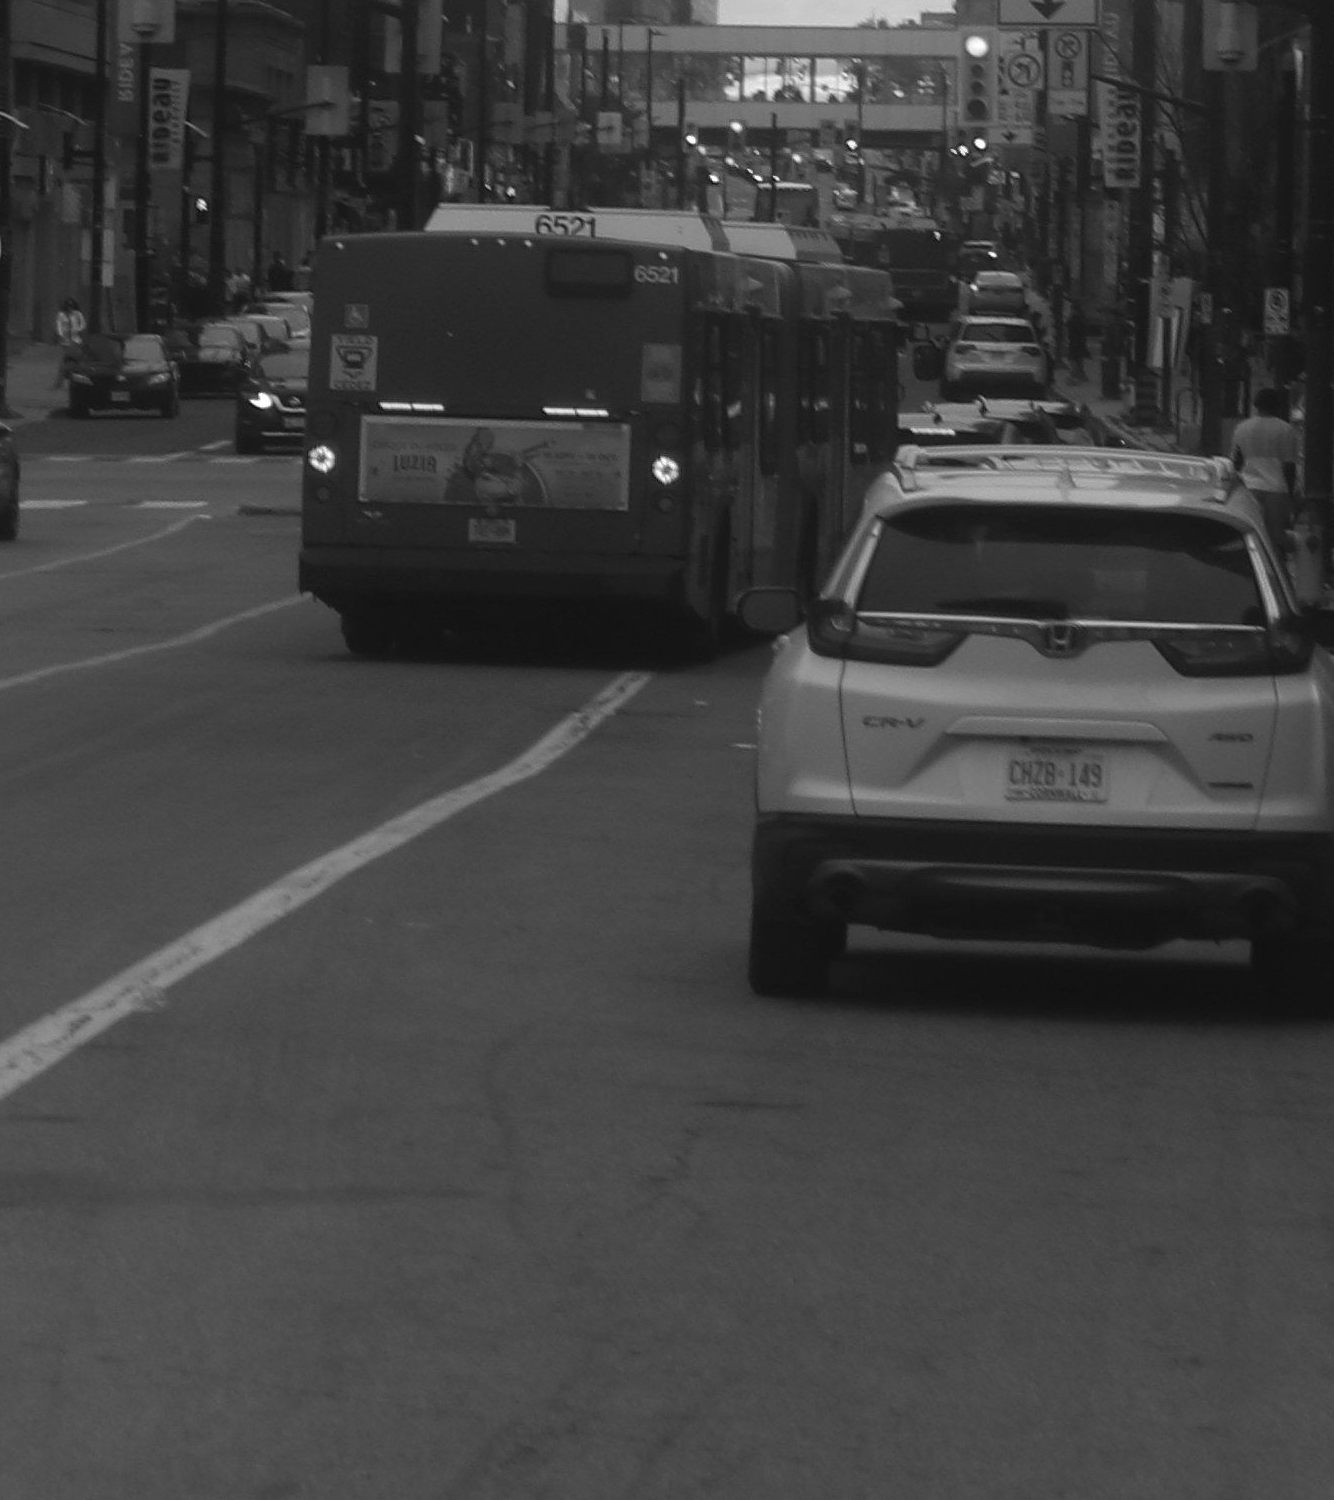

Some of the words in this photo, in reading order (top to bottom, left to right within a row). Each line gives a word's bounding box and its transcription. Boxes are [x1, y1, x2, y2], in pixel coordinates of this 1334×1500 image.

[535, 214, 597, 239] 6521
[632, 263, 680, 285] 6521
[392, 453, 438, 474] LUZIA
[862, 715, 924, 730] CR-V
